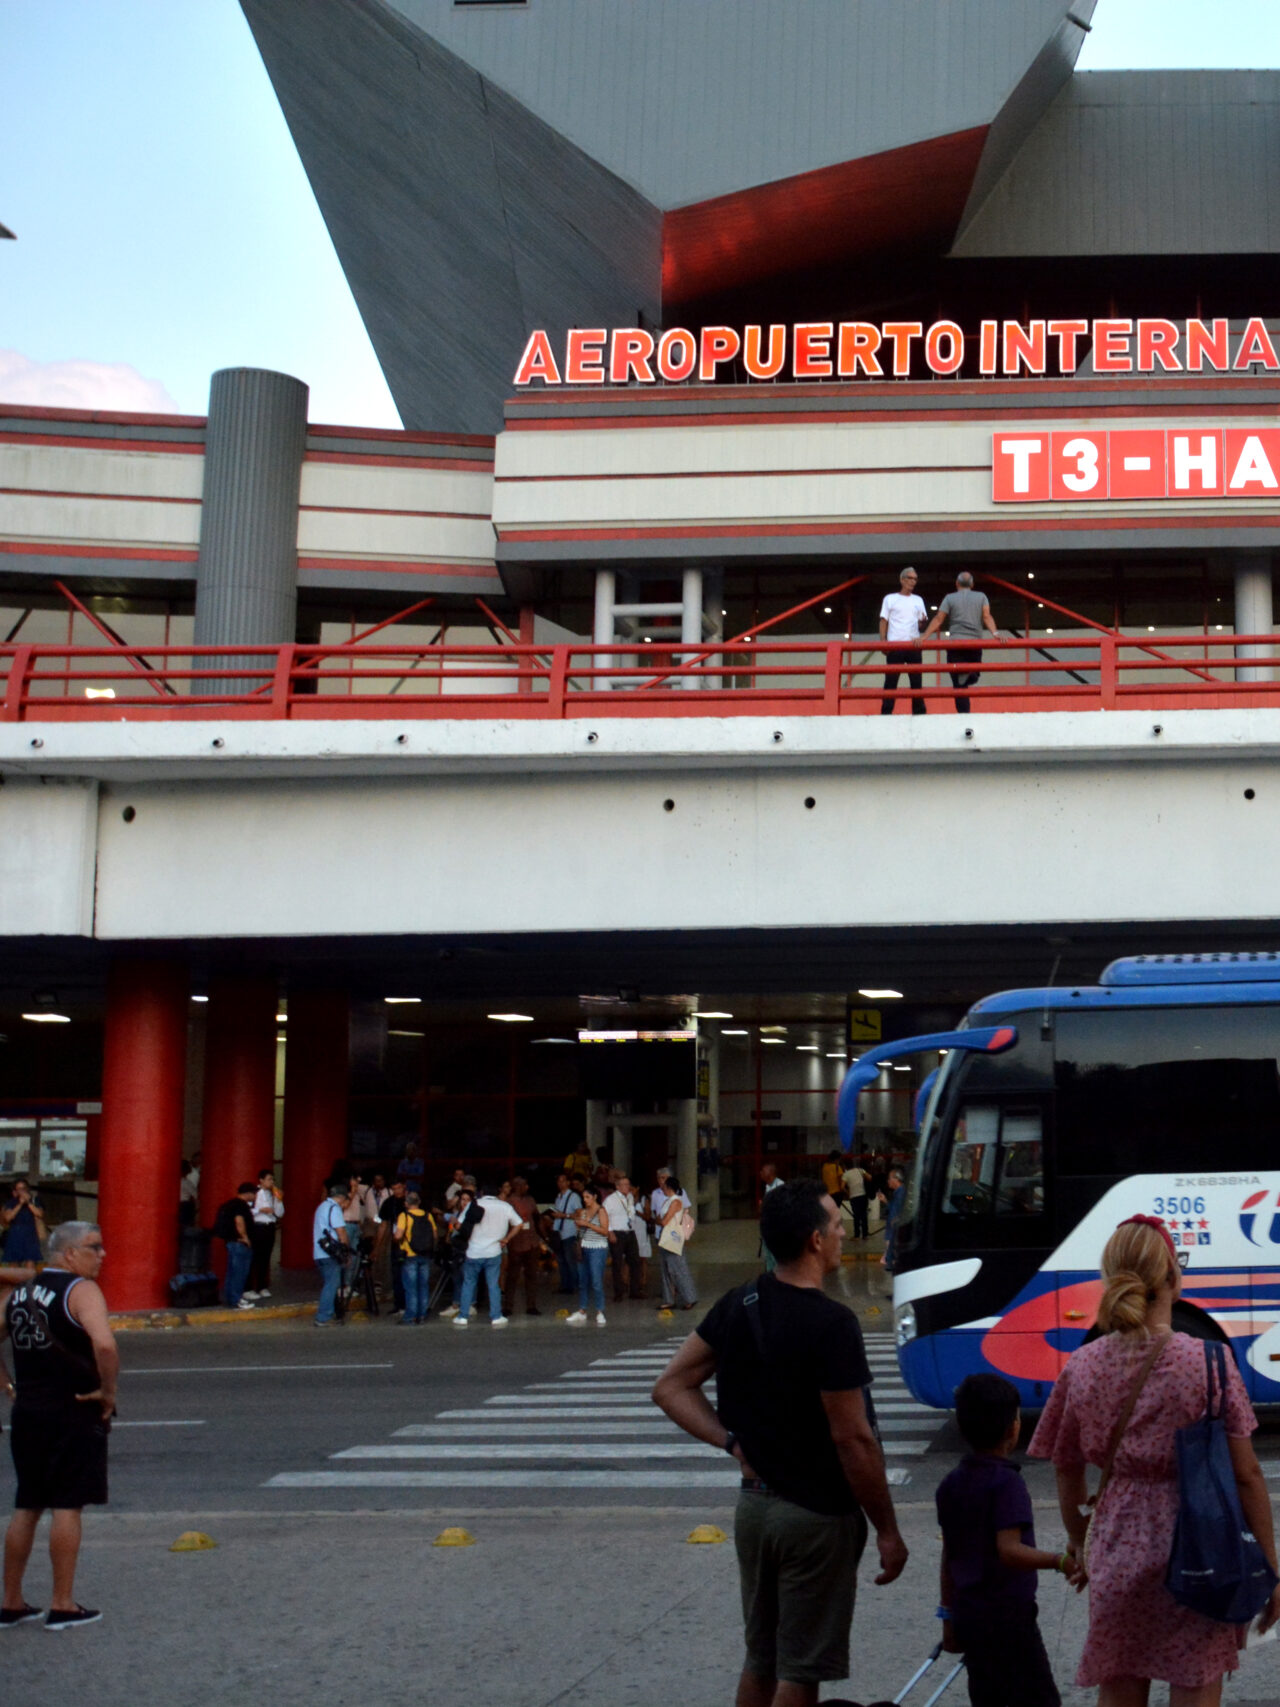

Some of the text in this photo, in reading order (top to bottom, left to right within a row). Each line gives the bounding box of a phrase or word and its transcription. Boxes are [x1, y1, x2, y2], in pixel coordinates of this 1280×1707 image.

[513, 320, 965, 384] AEROPUERTO
[1152, 1196, 1206, 1215] 3506
[12, 1284, 57, 1307] JODAN
